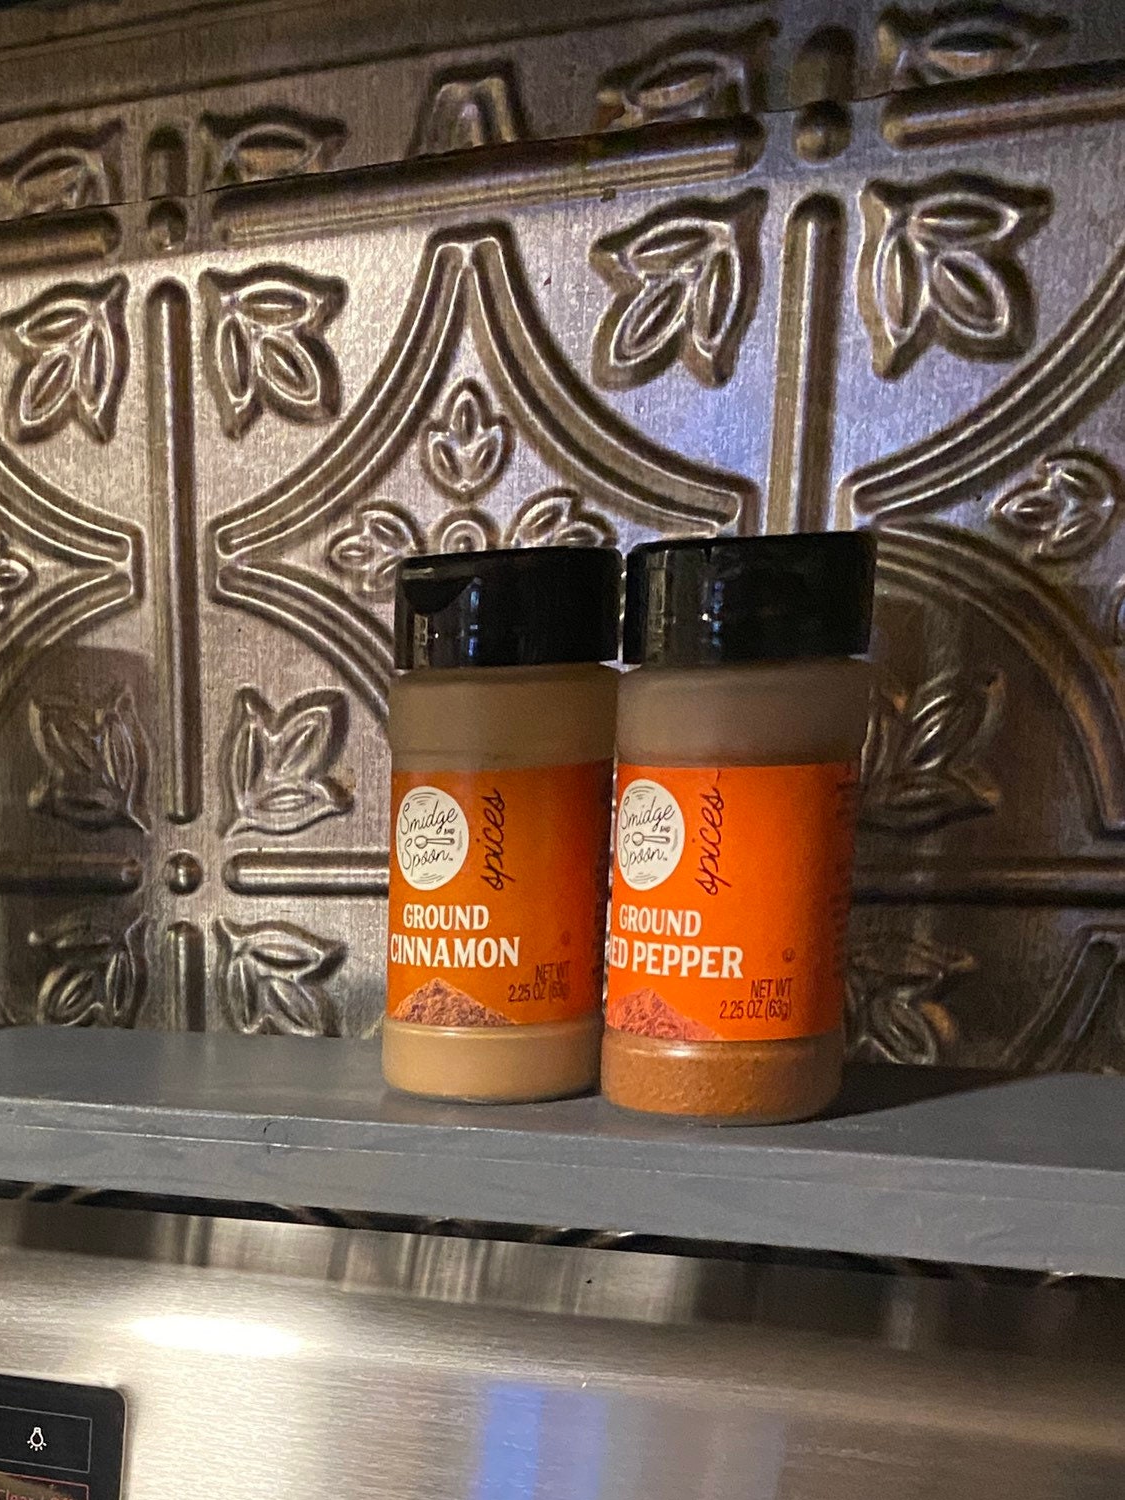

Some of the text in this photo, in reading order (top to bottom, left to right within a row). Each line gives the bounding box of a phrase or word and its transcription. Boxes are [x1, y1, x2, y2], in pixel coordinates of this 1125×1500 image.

[399, 800, 458, 836] Smidge
[621, 796, 675, 832] Smidge
[478, 788, 516, 891] spices
[692, 771, 732, 895] spices
[401, 838, 451, 877] Spoon
[620, 833, 665, 875] Spoon
[403, 903, 489, 930] GROUND
[619, 903, 702, 937] GROUND
[390, 934, 520, 968] CINNAMON
[632, 940, 743, 979] PEPPER
[535, 962, 554, 985] NET
[751, 977, 793, 998] NET WT
[720, 1000, 744, 1019] 2.25
[747, 999, 763, 1018] OZ
